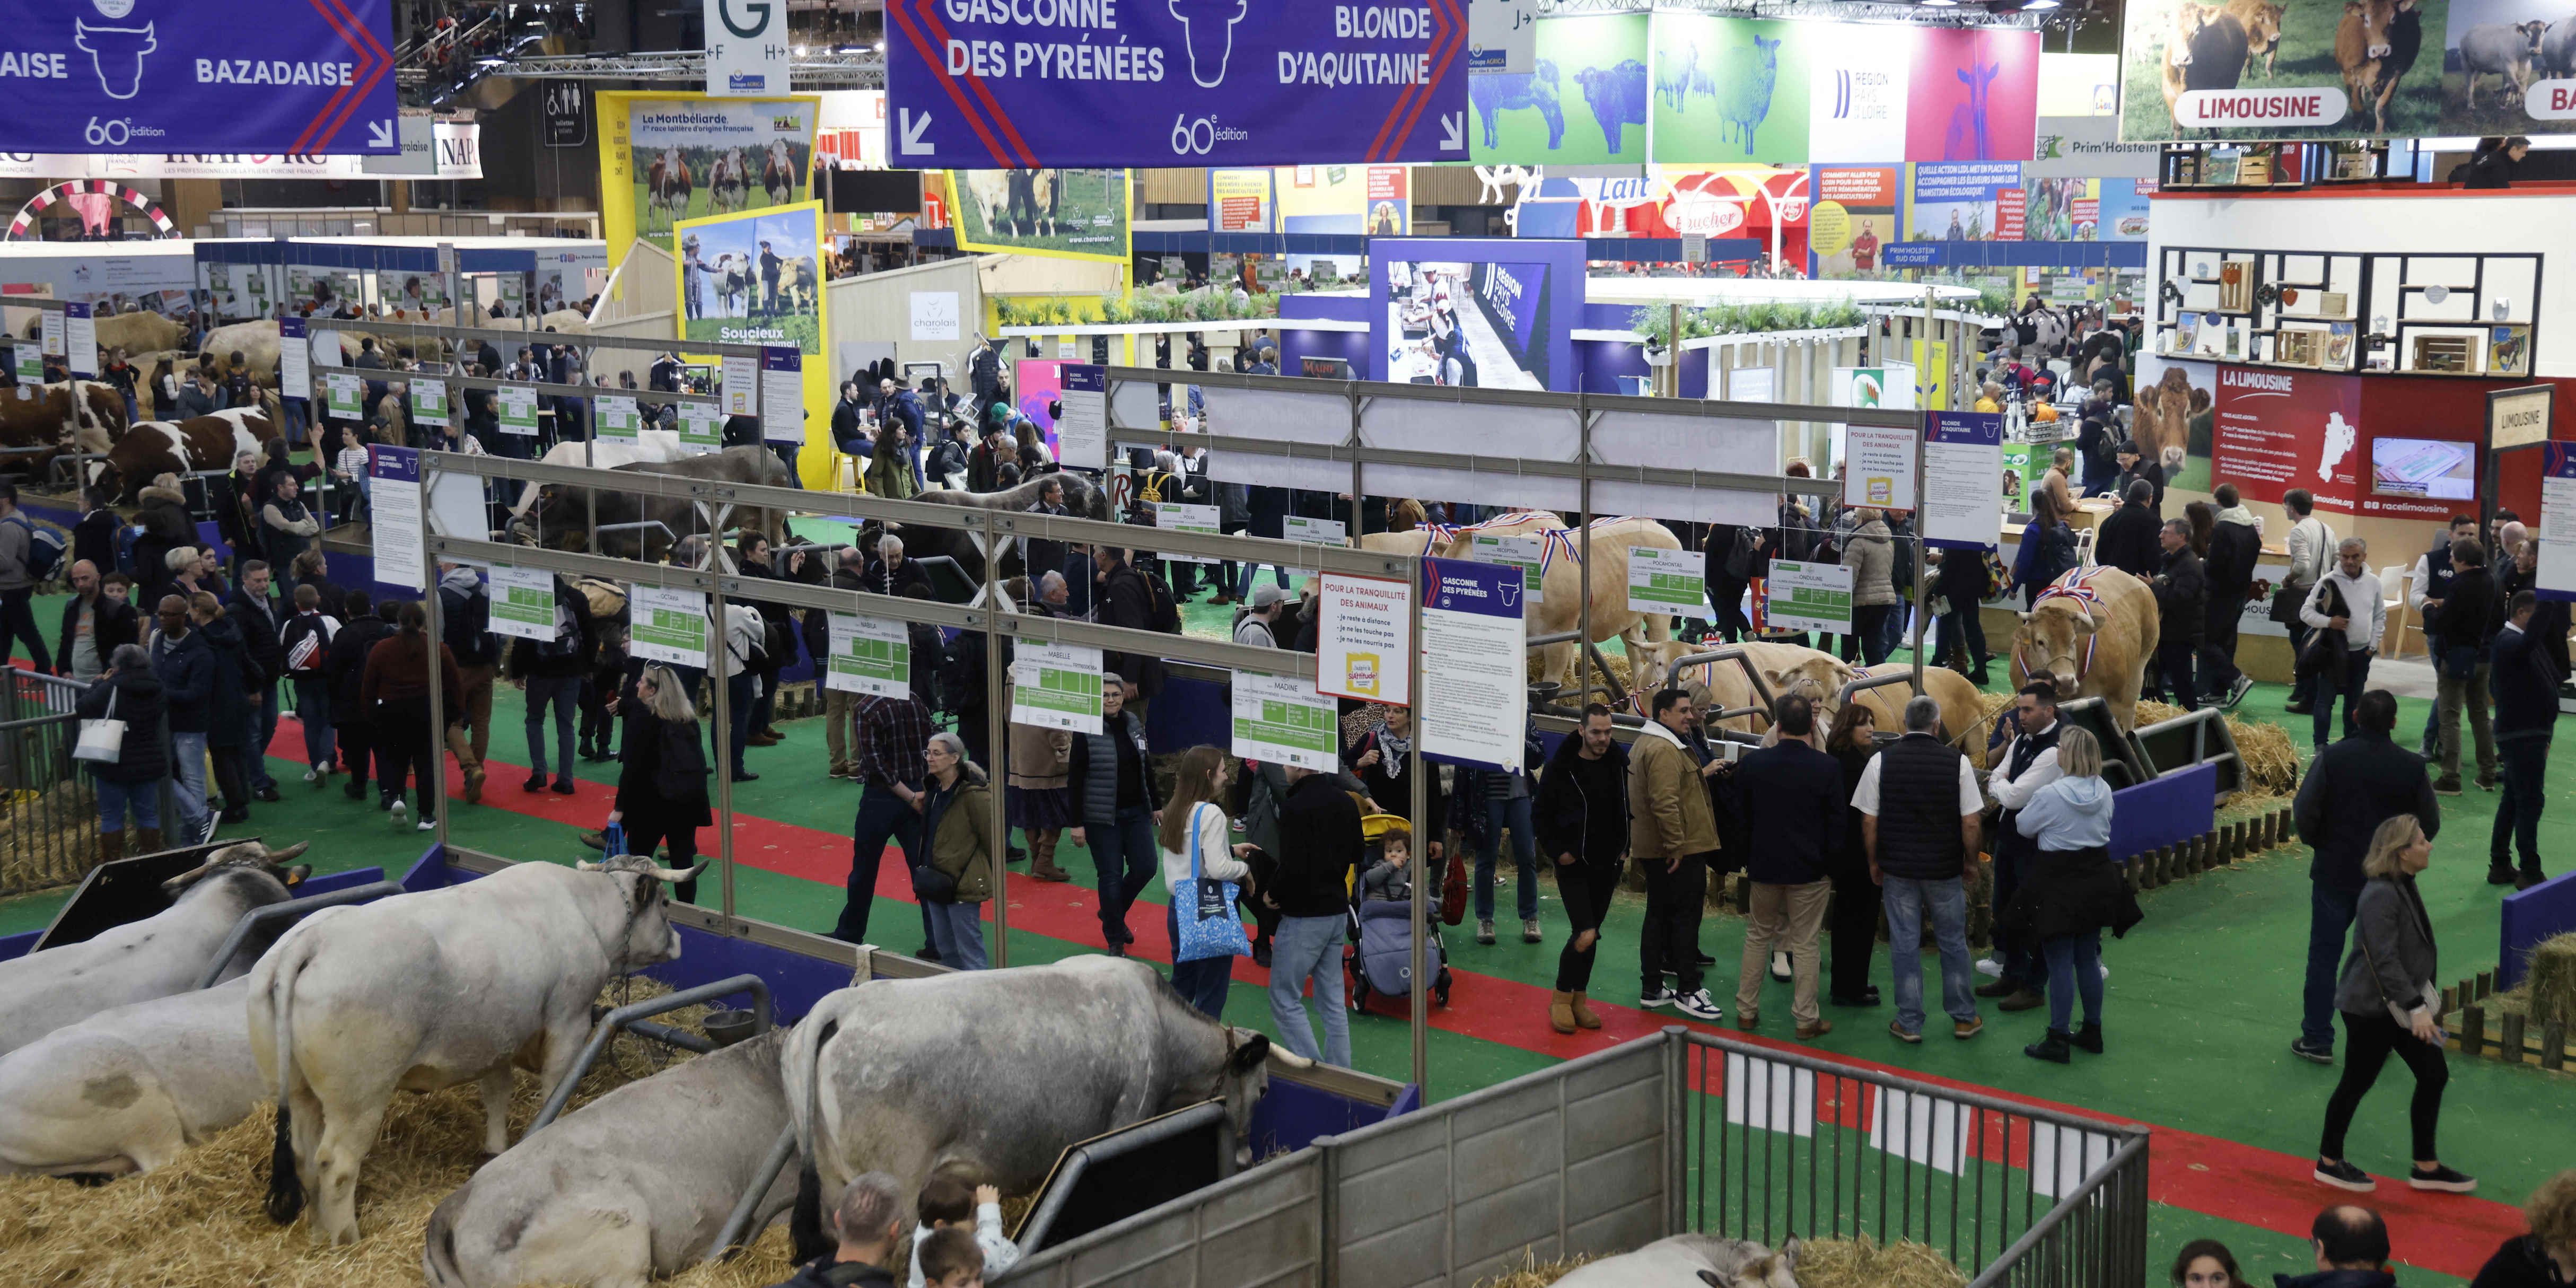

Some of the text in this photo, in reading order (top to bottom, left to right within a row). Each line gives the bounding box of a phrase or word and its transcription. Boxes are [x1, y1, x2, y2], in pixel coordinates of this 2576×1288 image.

[719, 0, 770, 38] G
[946, 0, 1117, 29] GASCONNE
[1336, 6, 1431, 39] BLONDE
[1513, 10, 1519, 30] J
[716, 44, 775, 59] F H
[948, 32, 1164, 82] DES PYRÉNÉES
[197, 59, 353, 86] BAZADAISE
[1278, 51, 1430, 88] D'AQUITAINE
[1862, 106, 1888, 119] LOIRE
[2198, 97, 2320, 119] LIMOUSINE
[643, 113, 729, 124] La Montbéliarde,
[130, 127, 165, 136] édition
[723, 125, 753, 133] française
[1216, 127, 1248, 141] édition
[400, 139, 428, 152] arolaise
[436, 138, 477, 165] INAP
[2073, 142, 2157, 153] Prim'Holstein
[1918, 166, 1938, 176] QUELLE
[1938, 165, 1957, 174] ACTION
[1599, 174, 1650, 200] Lait
[1497, 266, 1522, 300] RÉGION
[1494, 280, 1510, 306] PAYS
[1496, 299, 1516, 331] LOIRE
[721, 327, 784, 339] Soucieux
[2223, 370, 2292, 391] LA LIMOUSINE
[2502, 410, 2539, 428] LIMOUSINE
[2382, 503, 2449, 514] racelimousine
[1442, 577, 1478, 587] GASCONNE
[1325, 583, 1344, 593] POUR
[1356, 588, 1405, 600] TRANQUILLITÉ
[1456, 587, 1487, 598] PYRÉNÉES
[1355, 601, 1388, 611] ANIMAUX
[1367, 617, 1390, 626] distance
[1274, 683, 1298, 691] MADINE
